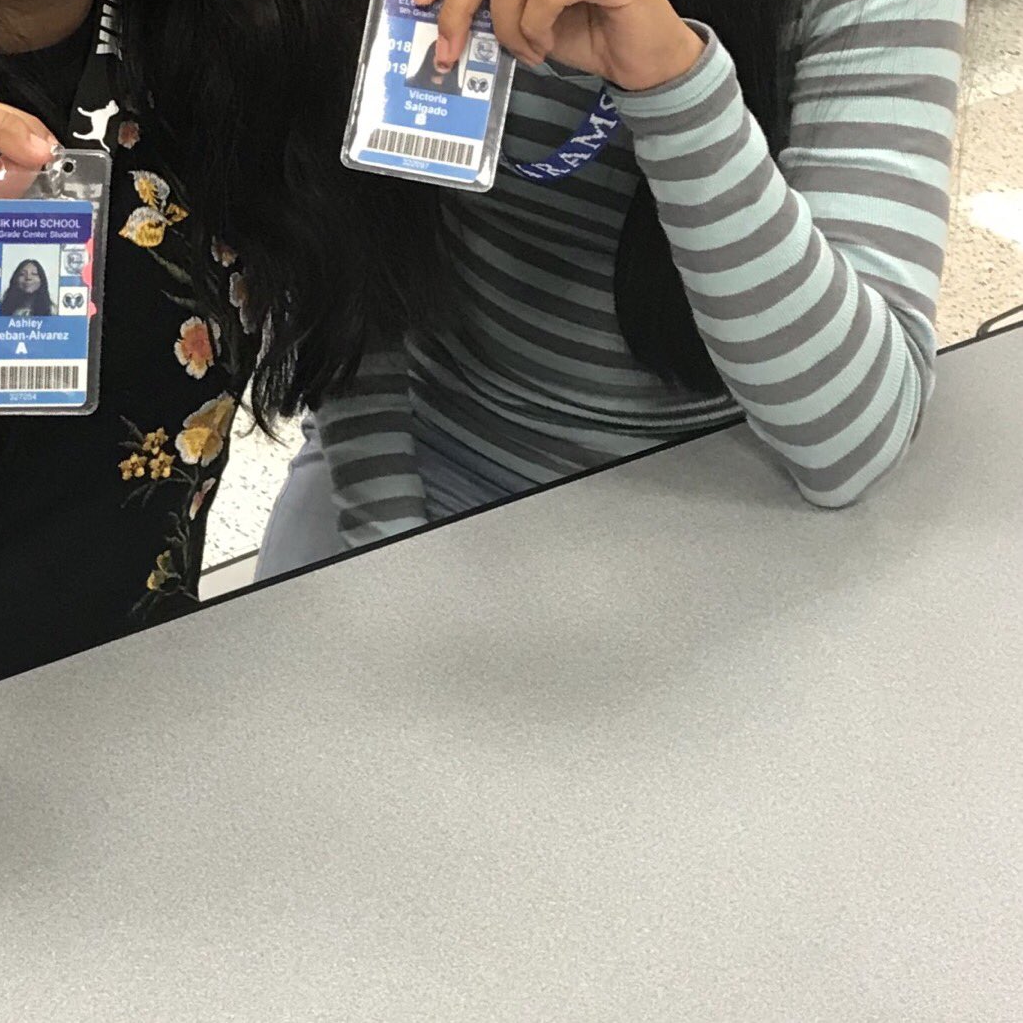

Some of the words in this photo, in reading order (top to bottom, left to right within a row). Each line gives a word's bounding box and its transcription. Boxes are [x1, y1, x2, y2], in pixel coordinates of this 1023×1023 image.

[389, 38, 412, 53] 018
[386, 60, 408, 75] 019
[409, 89, 448, 105] Victoria
[404, 100, 448, 117] Salgado
[12, 218, 37, 228] HIGH
[39, 218, 81, 228] SCHOOL
[22, 230, 48, 238] Center
[49, 230, 79, 239] Student
[8, 318, 43, 329] Ashley
[15, 341, 28, 354] A
